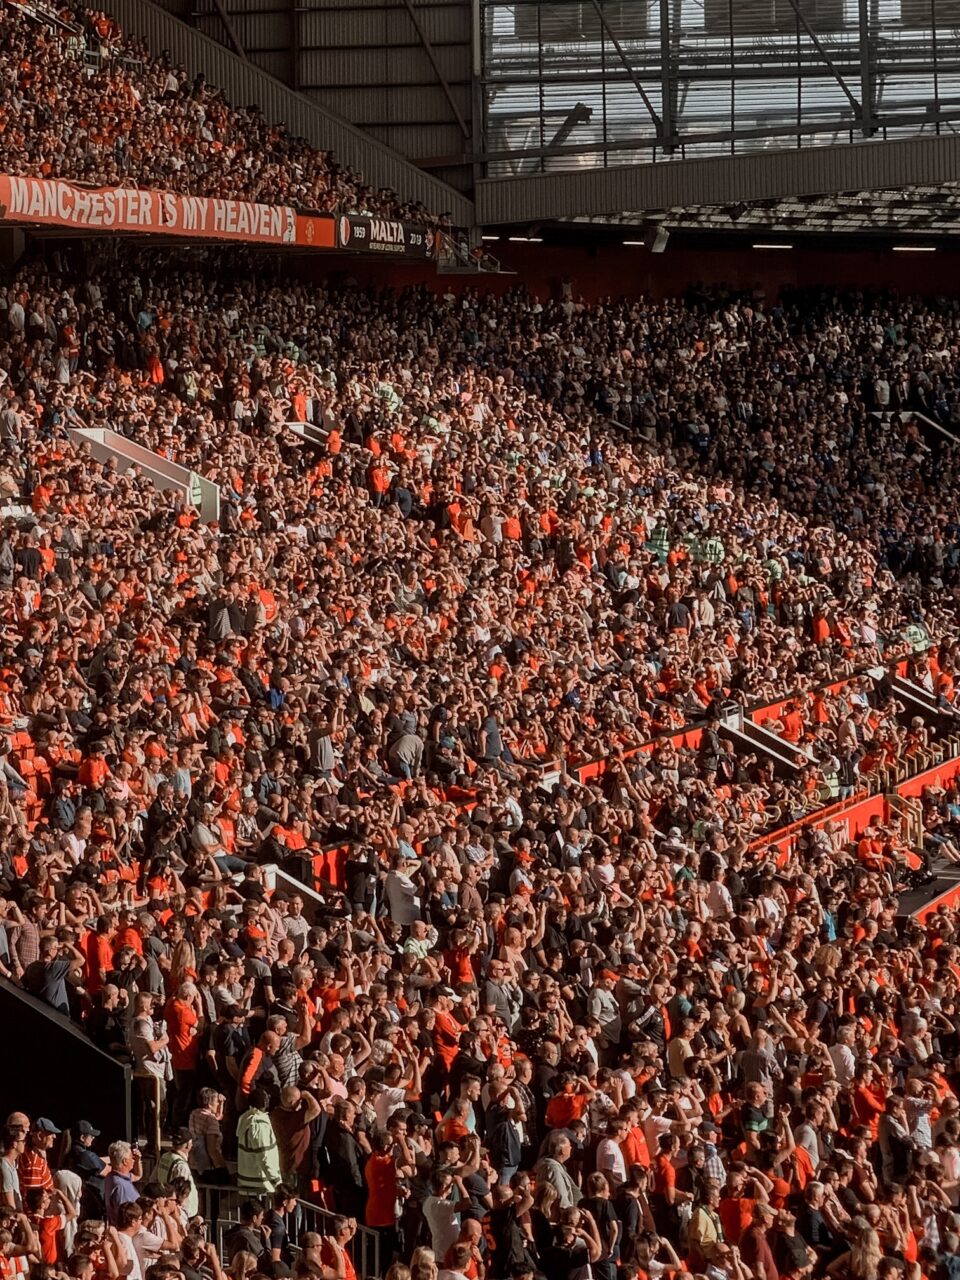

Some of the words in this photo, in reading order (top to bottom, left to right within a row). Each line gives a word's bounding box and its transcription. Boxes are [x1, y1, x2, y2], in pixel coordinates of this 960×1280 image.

[8, 176, 152, 227] MANCHESTER
[158, 191, 177, 228] IS
[181, 195, 208, 231] MY
[213, 198, 282, 237] HEAVEN
[369, 219, 405, 243] MALTA
